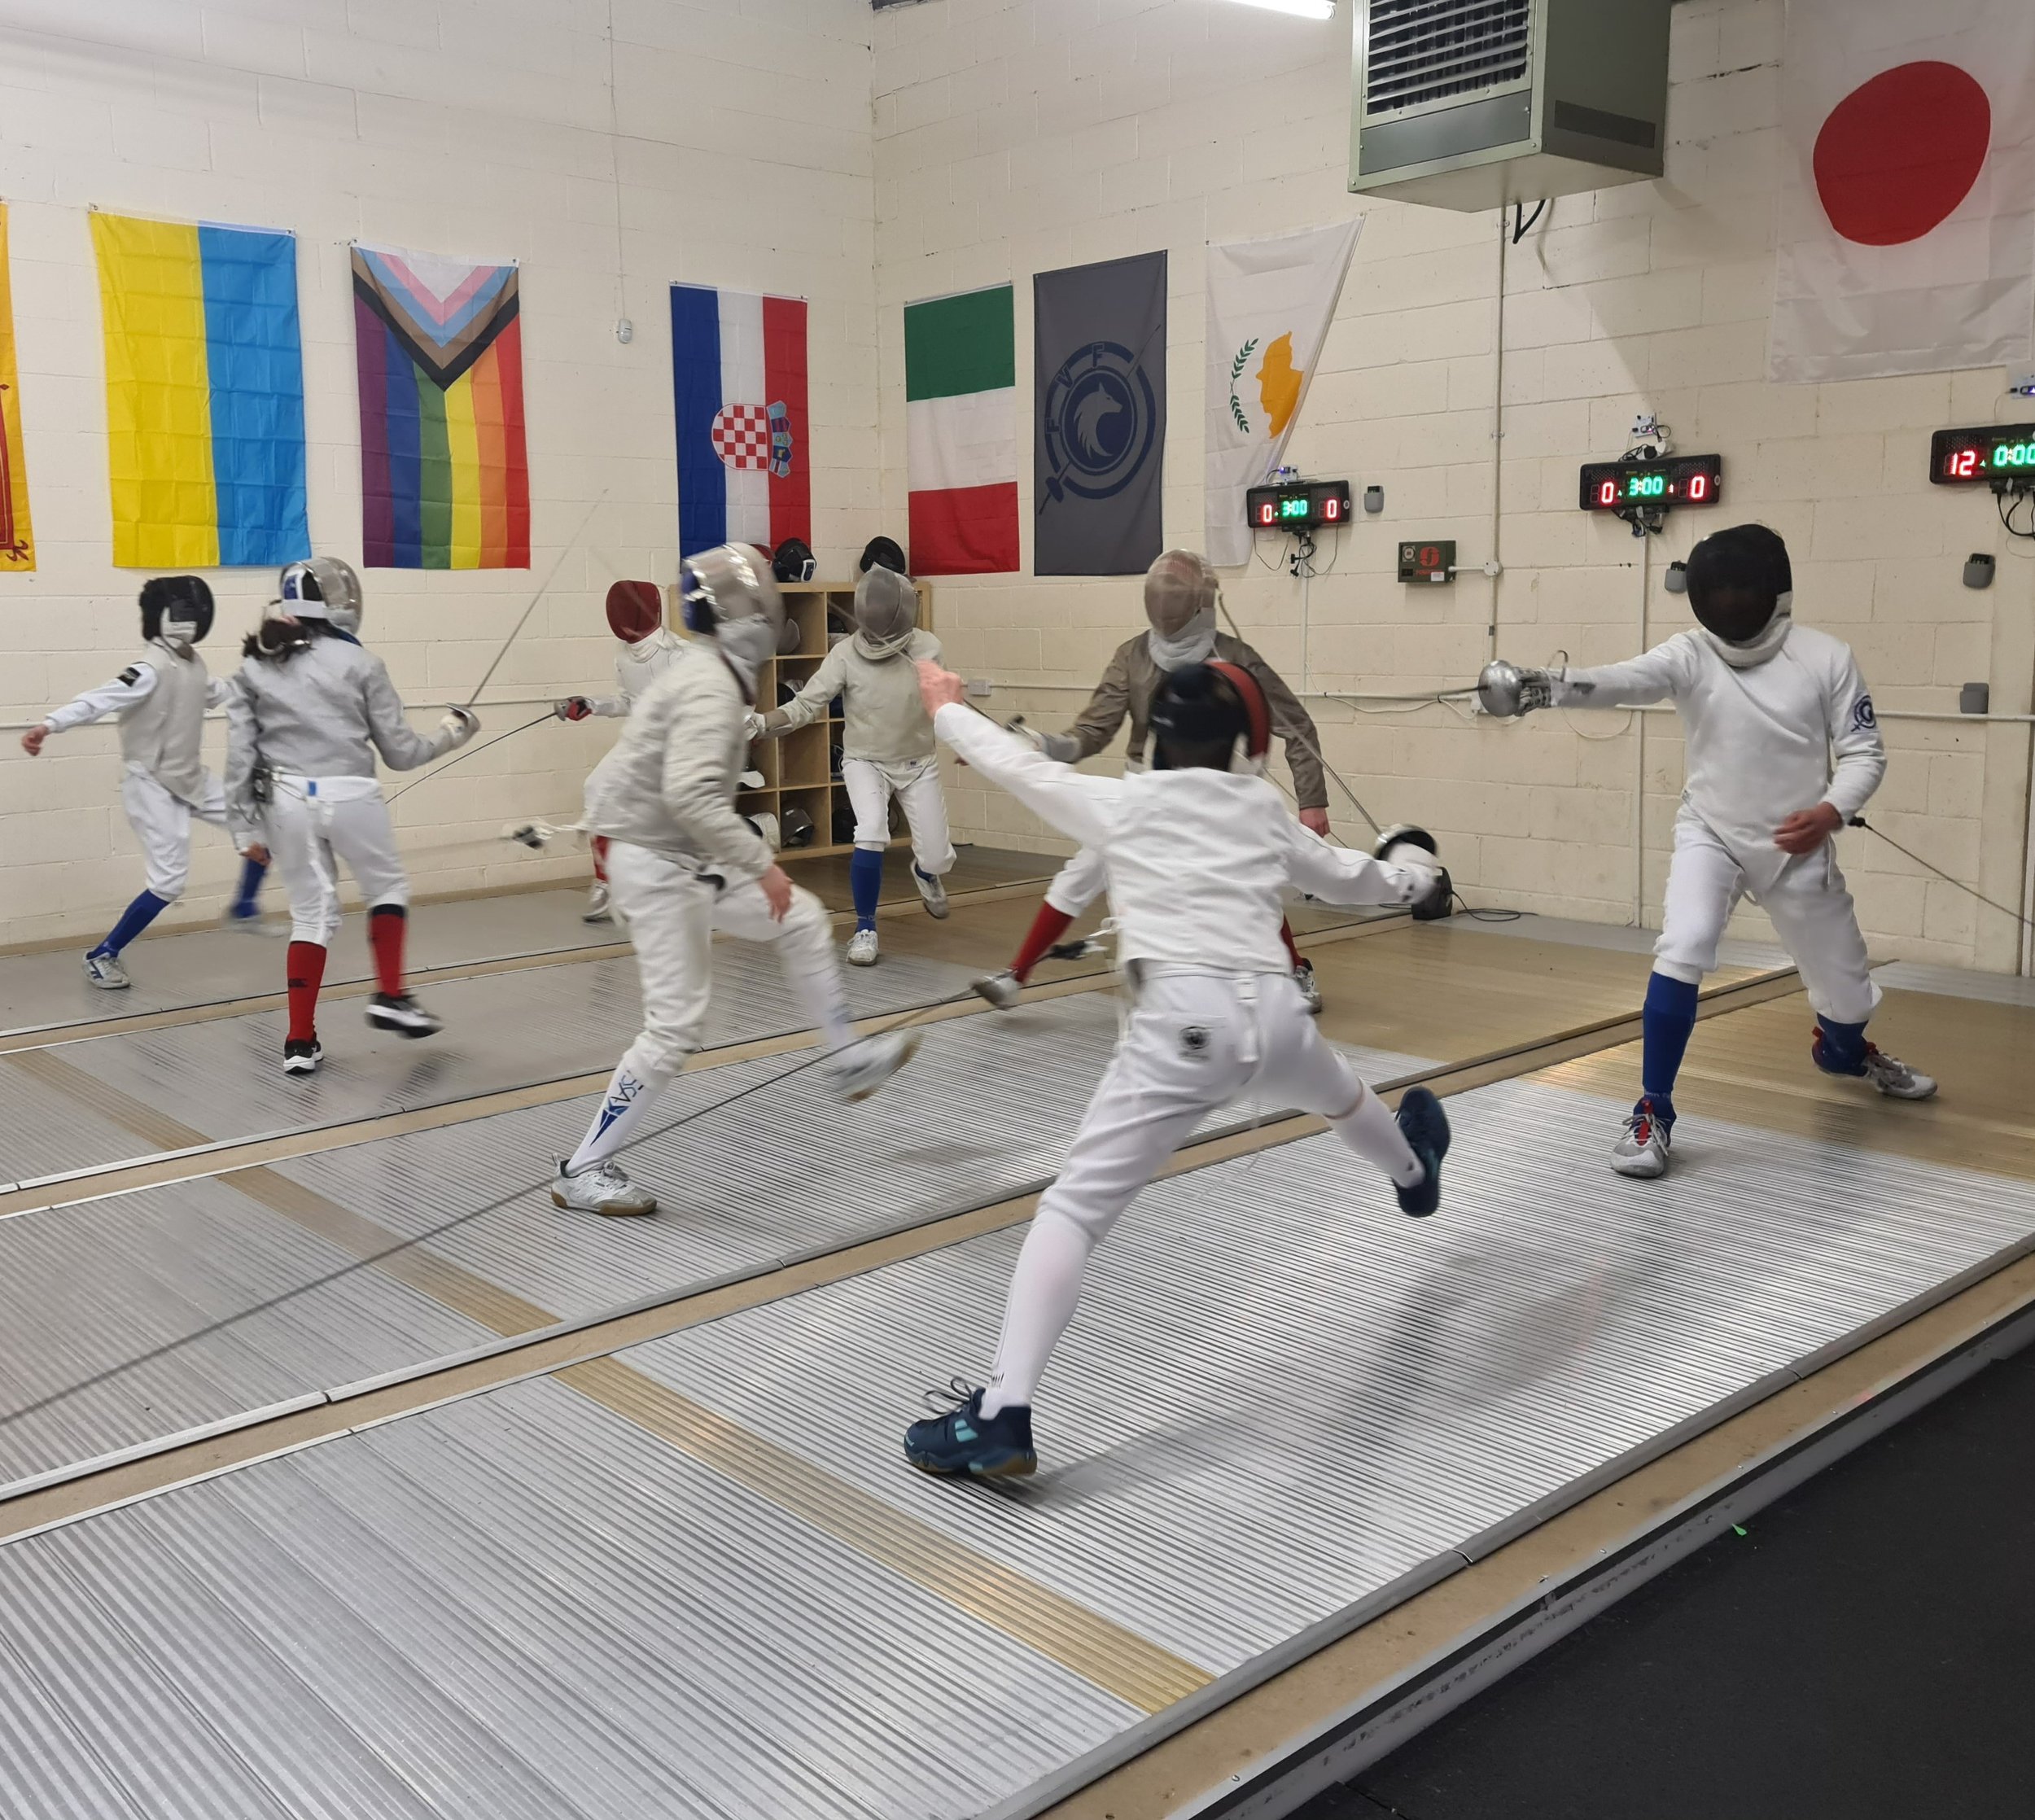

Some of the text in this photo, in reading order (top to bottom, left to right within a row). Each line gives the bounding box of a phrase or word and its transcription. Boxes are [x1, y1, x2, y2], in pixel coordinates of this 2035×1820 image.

[1949, 449, 1976, 476] 12
[1600, 475, 1705, 504] 0 3:00 0
[1262, 499, 1337, 523] 0 3:00 0
